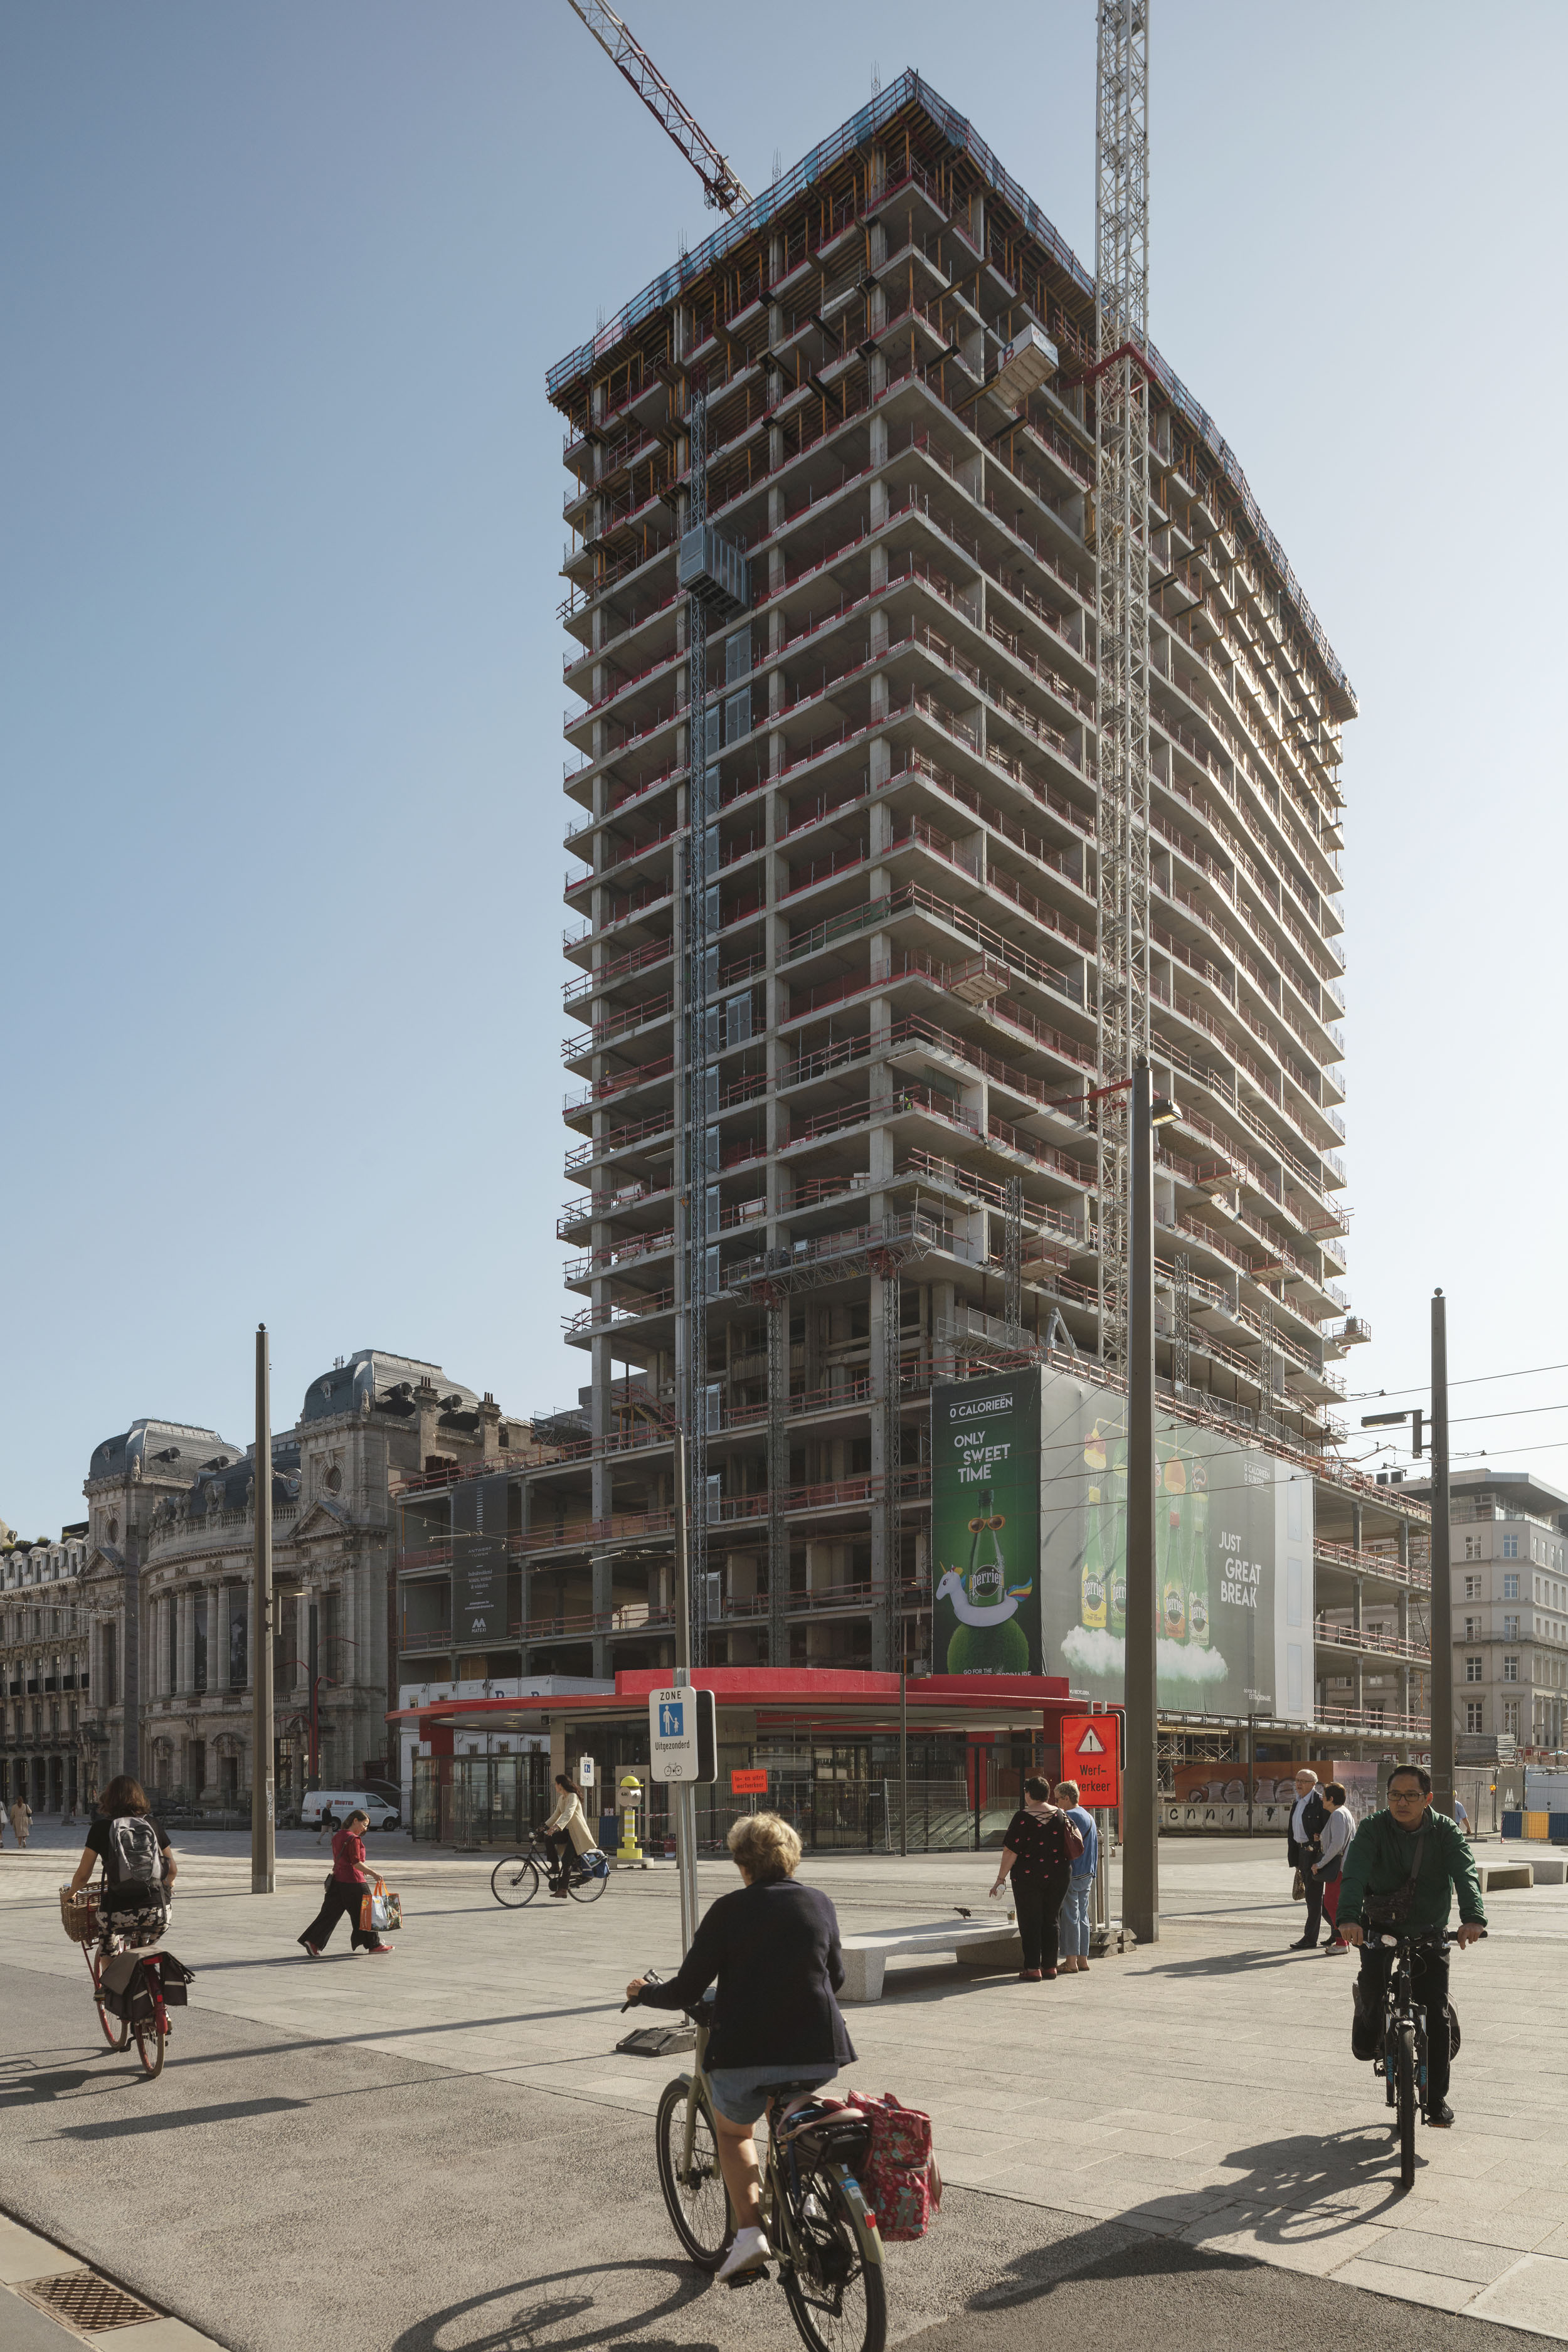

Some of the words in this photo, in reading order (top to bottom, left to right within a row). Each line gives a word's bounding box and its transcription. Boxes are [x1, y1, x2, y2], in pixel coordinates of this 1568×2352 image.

[950, 1408, 956, 1418] 0
[959, 1396, 1013, 1416] CALORIEËN
[954, 1431, 986, 1448] ONLY
[963, 1443, 1010, 1465] SWEET
[958, 1464, 992, 1483] TIME
[1219, 1531, 1241, 1552] JUST
[1226, 1557, 1261, 1585] GREAT
[971, 1569, 1003, 1596] perrier
[1221, 1580, 1257, 1608] BREAK
[660, 1690, 682, 1700] ZONE
[655, 1740, 690, 1752] Uitgezonderd
[1079, 1764, 1106, 1776] Werf-
